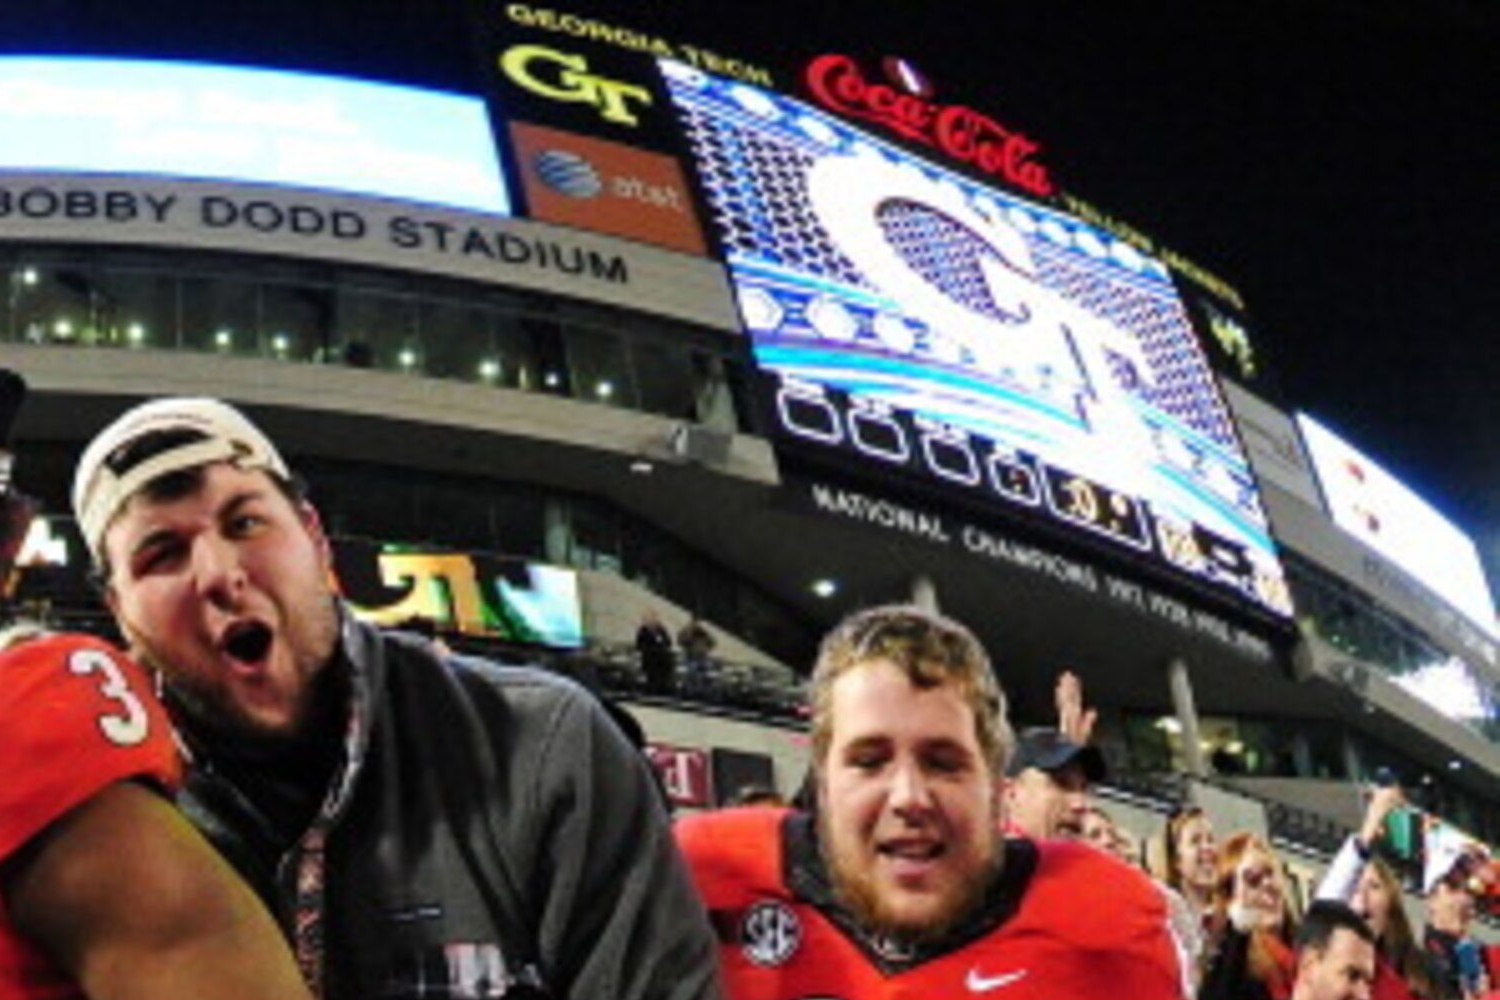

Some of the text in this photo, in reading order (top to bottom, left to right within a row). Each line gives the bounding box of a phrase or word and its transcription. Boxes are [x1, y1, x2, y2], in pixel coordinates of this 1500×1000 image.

[499, 44, 651, 126] GT
[505, 3, 774, 87] GEORGIA TECH
[806, 53, 1052, 197] Coca-Cola
[200, 196, 367, 240] DODD
[389, 215, 628, 284] STADIUM
[811, 484, 950, 542] NATIONAL
[70, 649, 150, 746] 3
